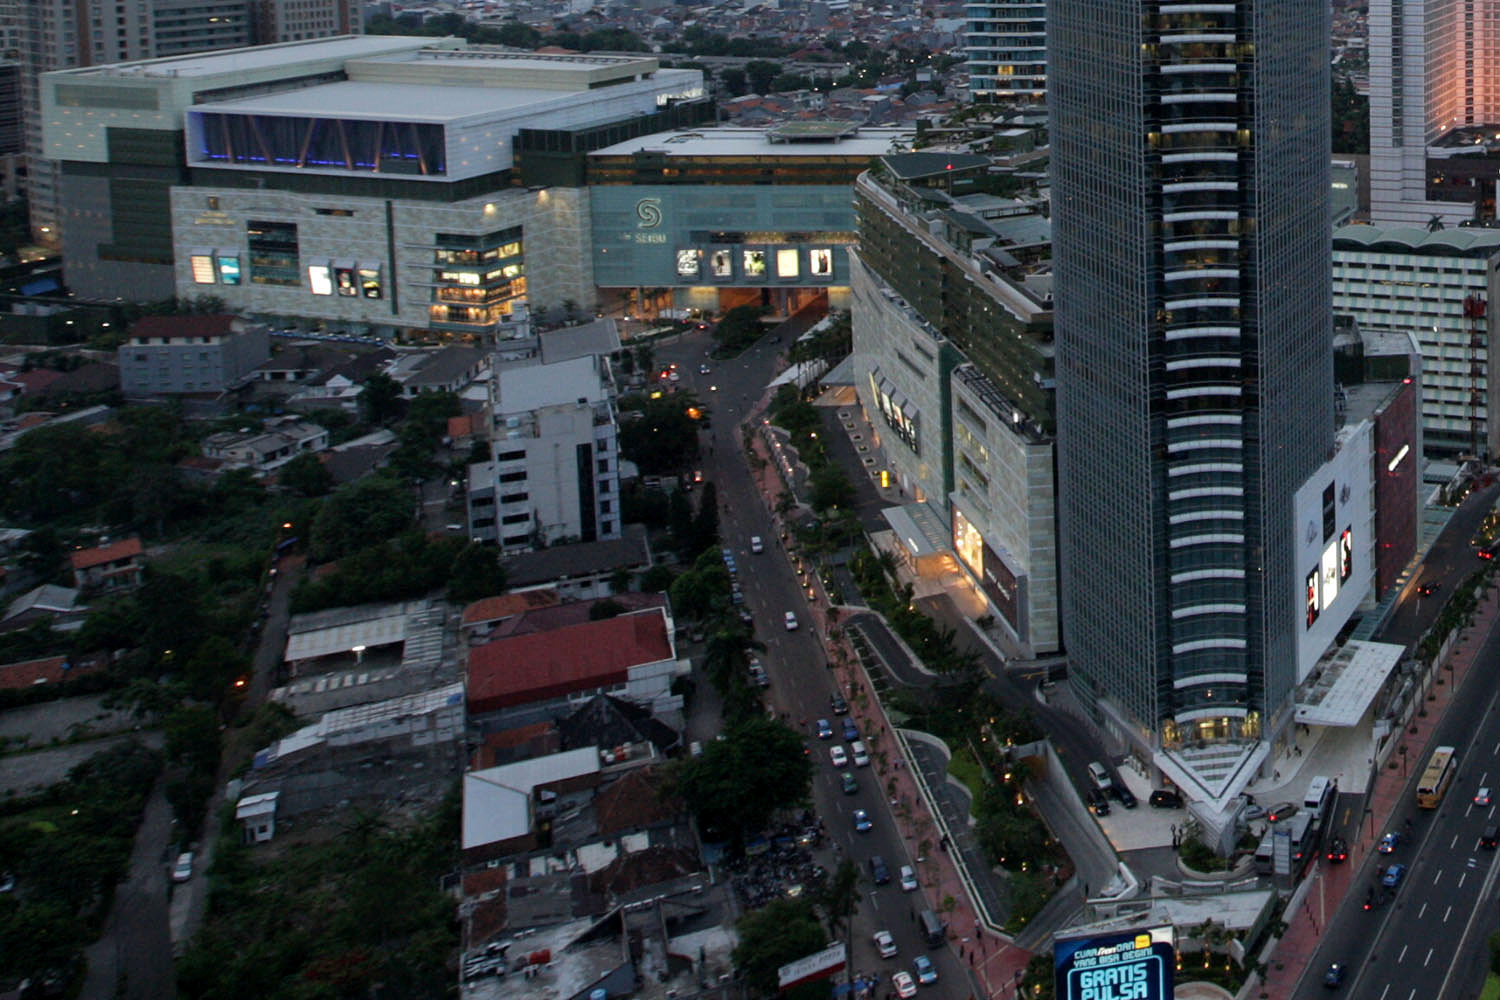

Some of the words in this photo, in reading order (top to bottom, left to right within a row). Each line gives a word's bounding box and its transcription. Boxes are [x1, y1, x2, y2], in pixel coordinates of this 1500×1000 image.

[1073, 957, 1097, 969] YANG
[1099, 953, 1120, 964] BISA
[1080, 962, 1147, 989] GRATIS
[1081, 981, 1148, 1000] PULSA
